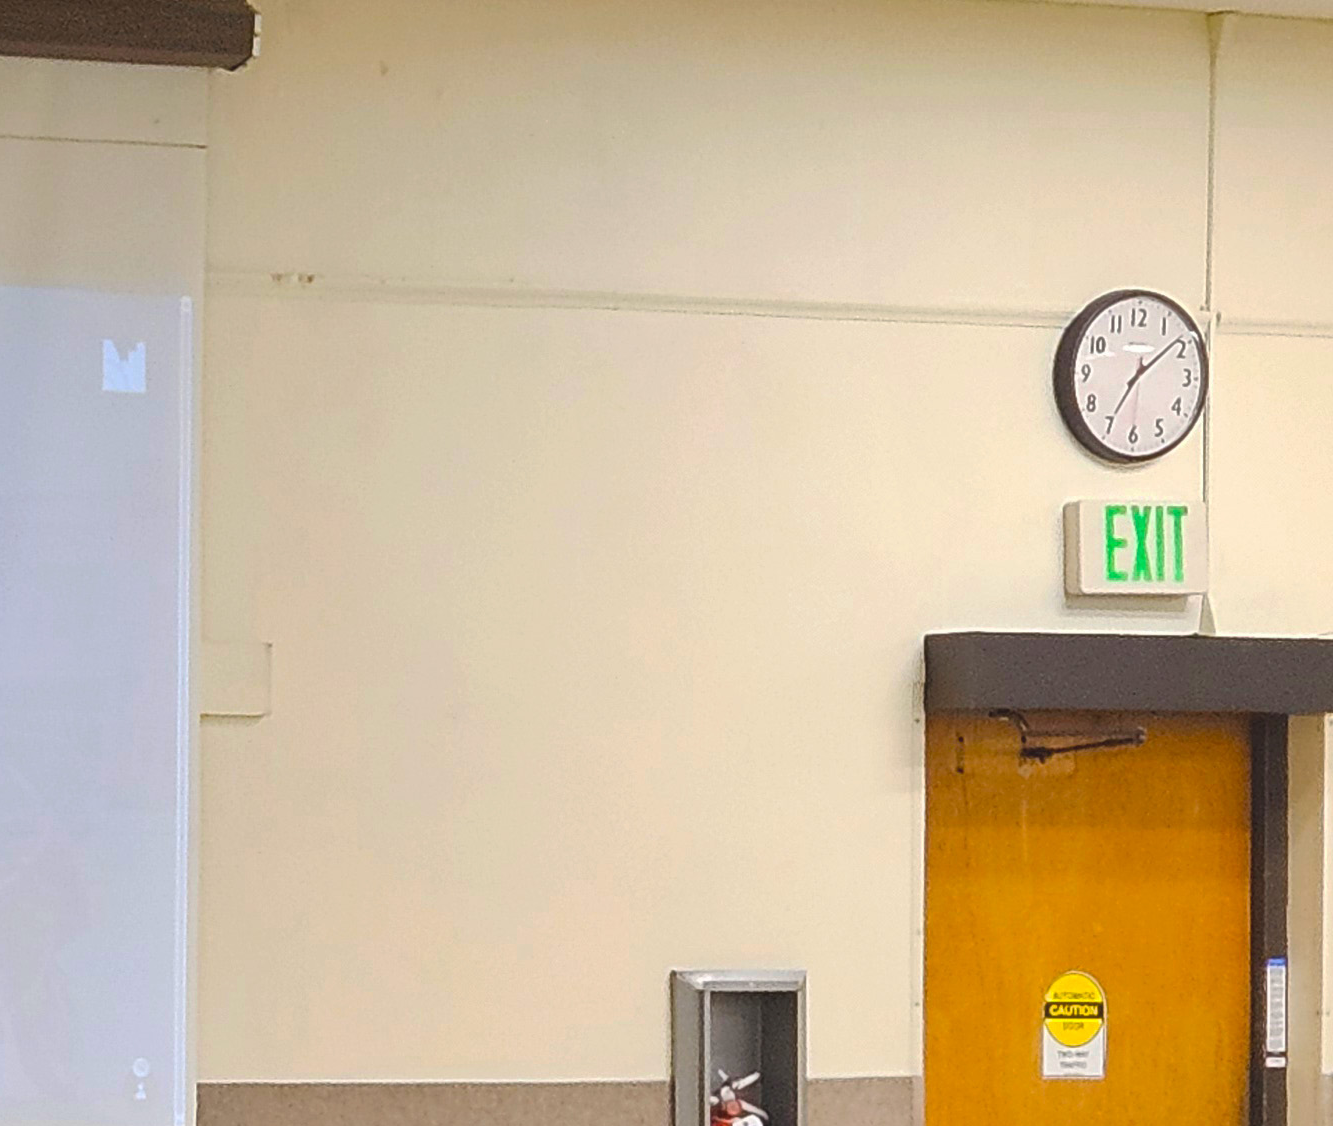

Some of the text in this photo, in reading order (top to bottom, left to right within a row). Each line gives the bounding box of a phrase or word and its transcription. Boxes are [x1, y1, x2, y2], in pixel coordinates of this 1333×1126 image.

[1110, 315, 1122, 334] 11
[1130, 308, 1147, 327] 12
[1162, 317, 1167, 336] 1
[1090, 335, 1106, 354] 10
[1175, 336, 1186, 359] 2
[1081, 364, 1091, 383] 9
[1182, 368, 1192, 387] 3
[1086, 394, 1096, 412] 8
[1171, 397, 1182, 416] 4
[1105, 416, 1115, 434] 7
[1128, 425, 1138, 444] 6
[1154, 419, 1164, 437] 5
[1105, 505, 1188, 582] EXIT
[1049, 1004, 1099, 1017] CAUTION
